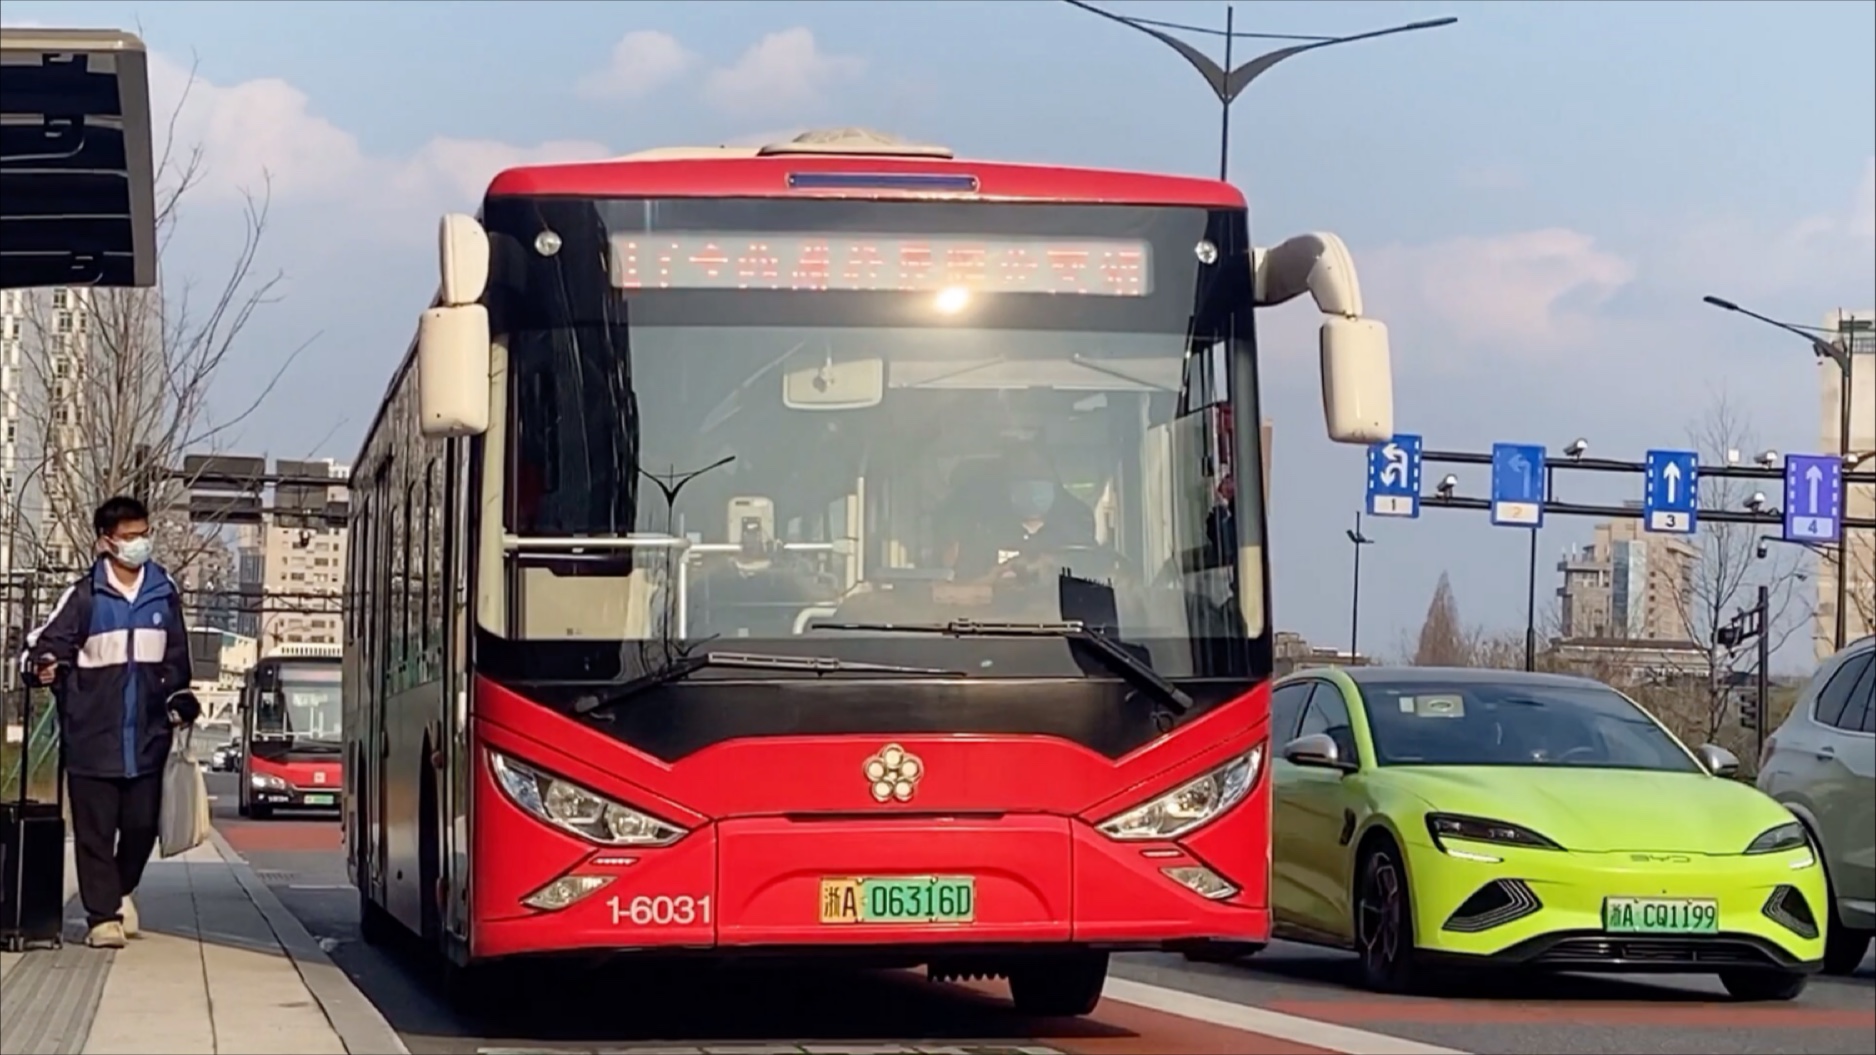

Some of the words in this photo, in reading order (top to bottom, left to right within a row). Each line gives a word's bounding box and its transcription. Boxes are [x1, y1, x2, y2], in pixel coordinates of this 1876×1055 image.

[1666, 514, 1676, 528] 3
[1807, 520, 1818, 535] 4
[606, 896, 710, 925] 1-6031
